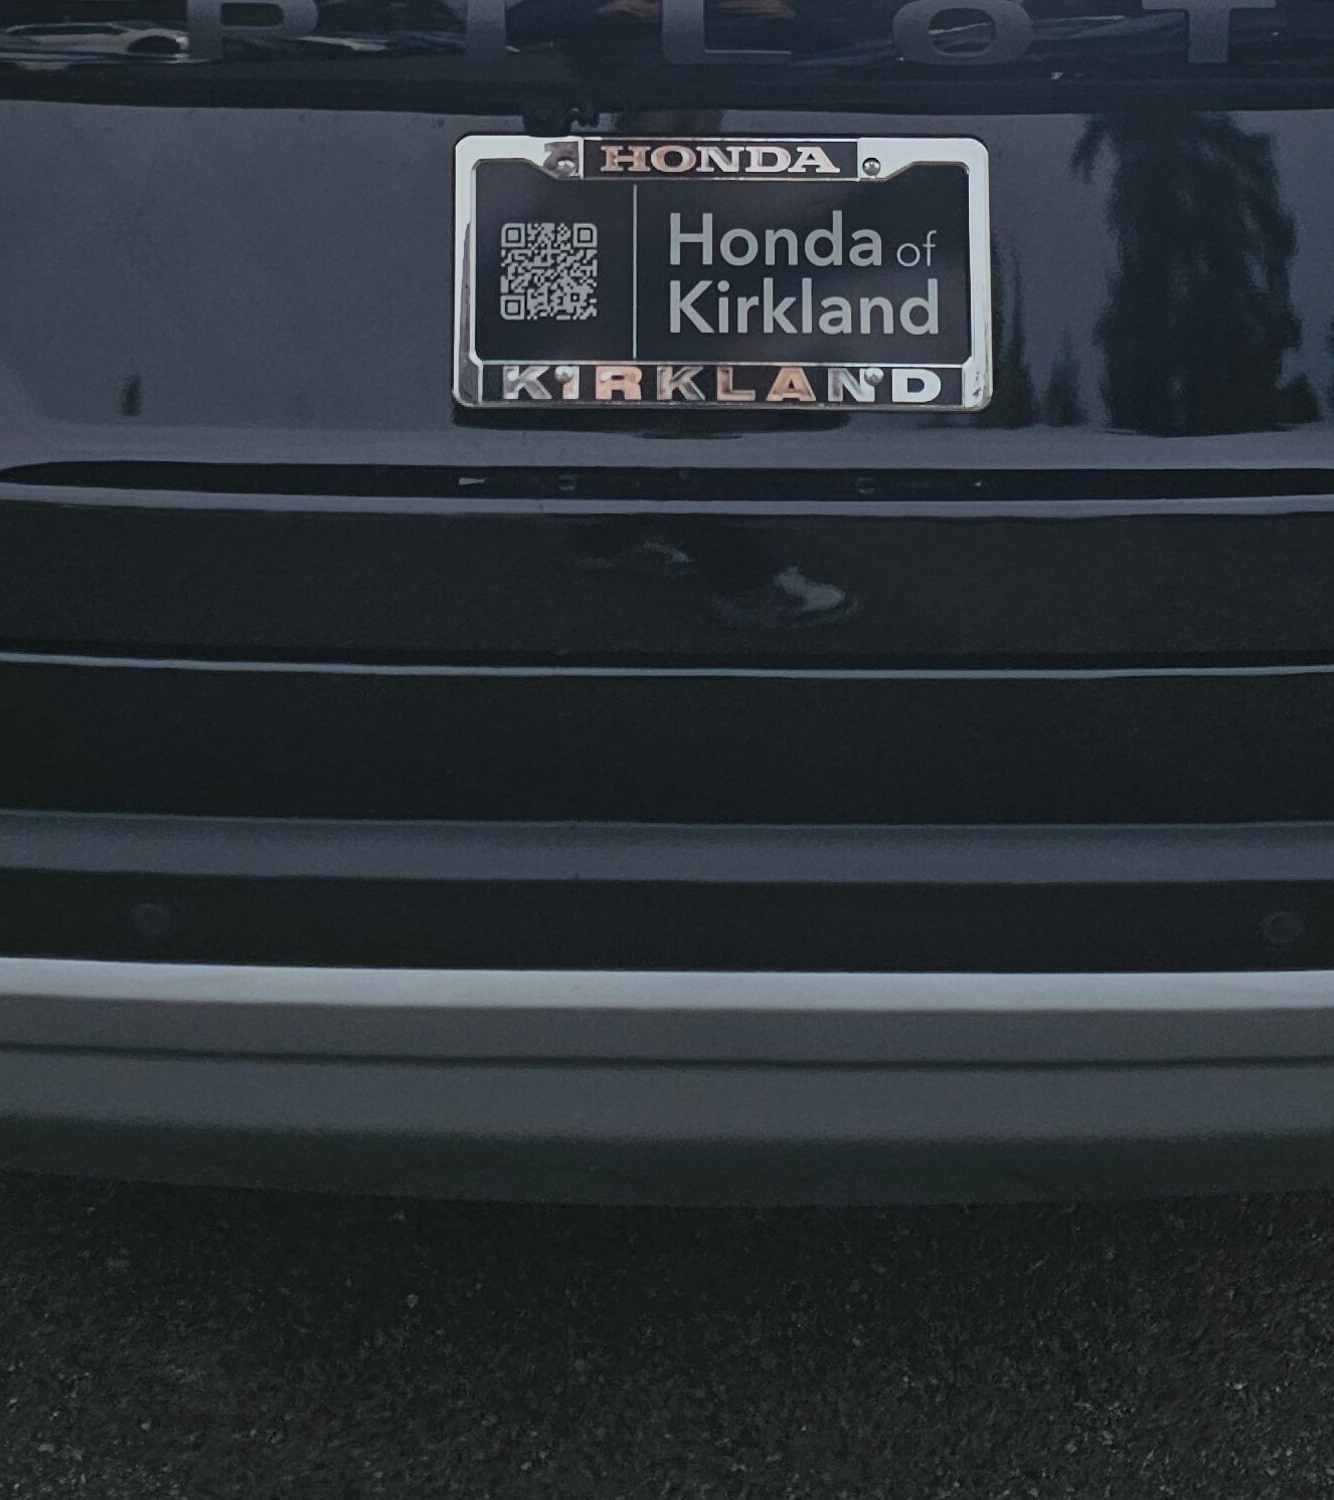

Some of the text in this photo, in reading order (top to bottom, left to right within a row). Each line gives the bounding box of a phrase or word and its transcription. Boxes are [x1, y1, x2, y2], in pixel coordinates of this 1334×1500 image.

[600, 145, 840, 173] HONDA
[669, 210, 937, 267] Honda of
[669, 278, 940, 336] Kirkland
[502, 365, 942, 403] KIRKLAND
